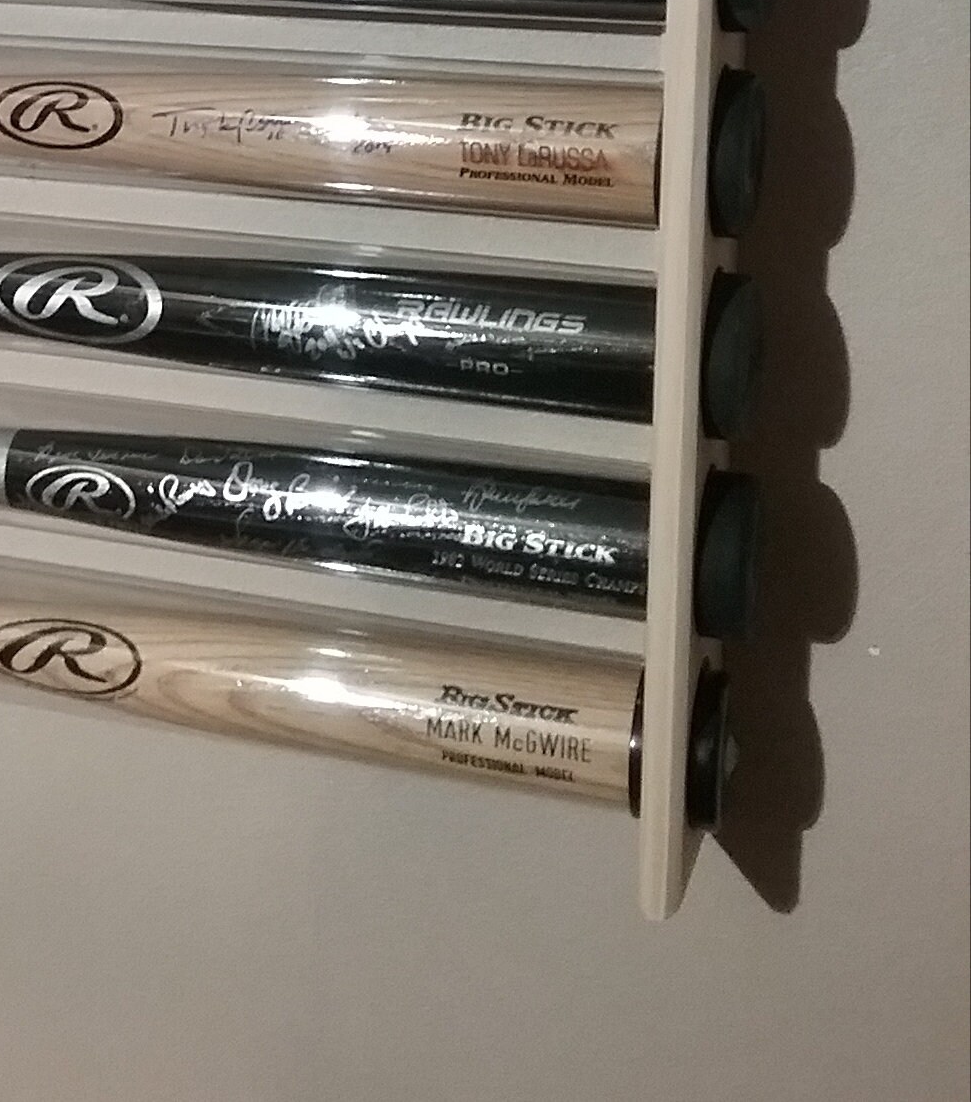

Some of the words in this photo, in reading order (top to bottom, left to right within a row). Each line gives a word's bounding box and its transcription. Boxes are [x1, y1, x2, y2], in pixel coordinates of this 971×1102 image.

[459, 112, 514, 131] BIG
[524, 115, 619, 139] STICK
[459, 141, 512, 165] TONY
[396, 299, 587, 334] RAWLINGS
[462, 523, 518, 551] BIG
[523, 532, 619, 565] STICK
[471, 554, 525, 578] WORLD
[435, 684, 490, 710] BIG
[490, 693, 580, 724] STICK
[426, 717, 484, 744] MARK
[493, 726, 594, 763] McGWIRE
